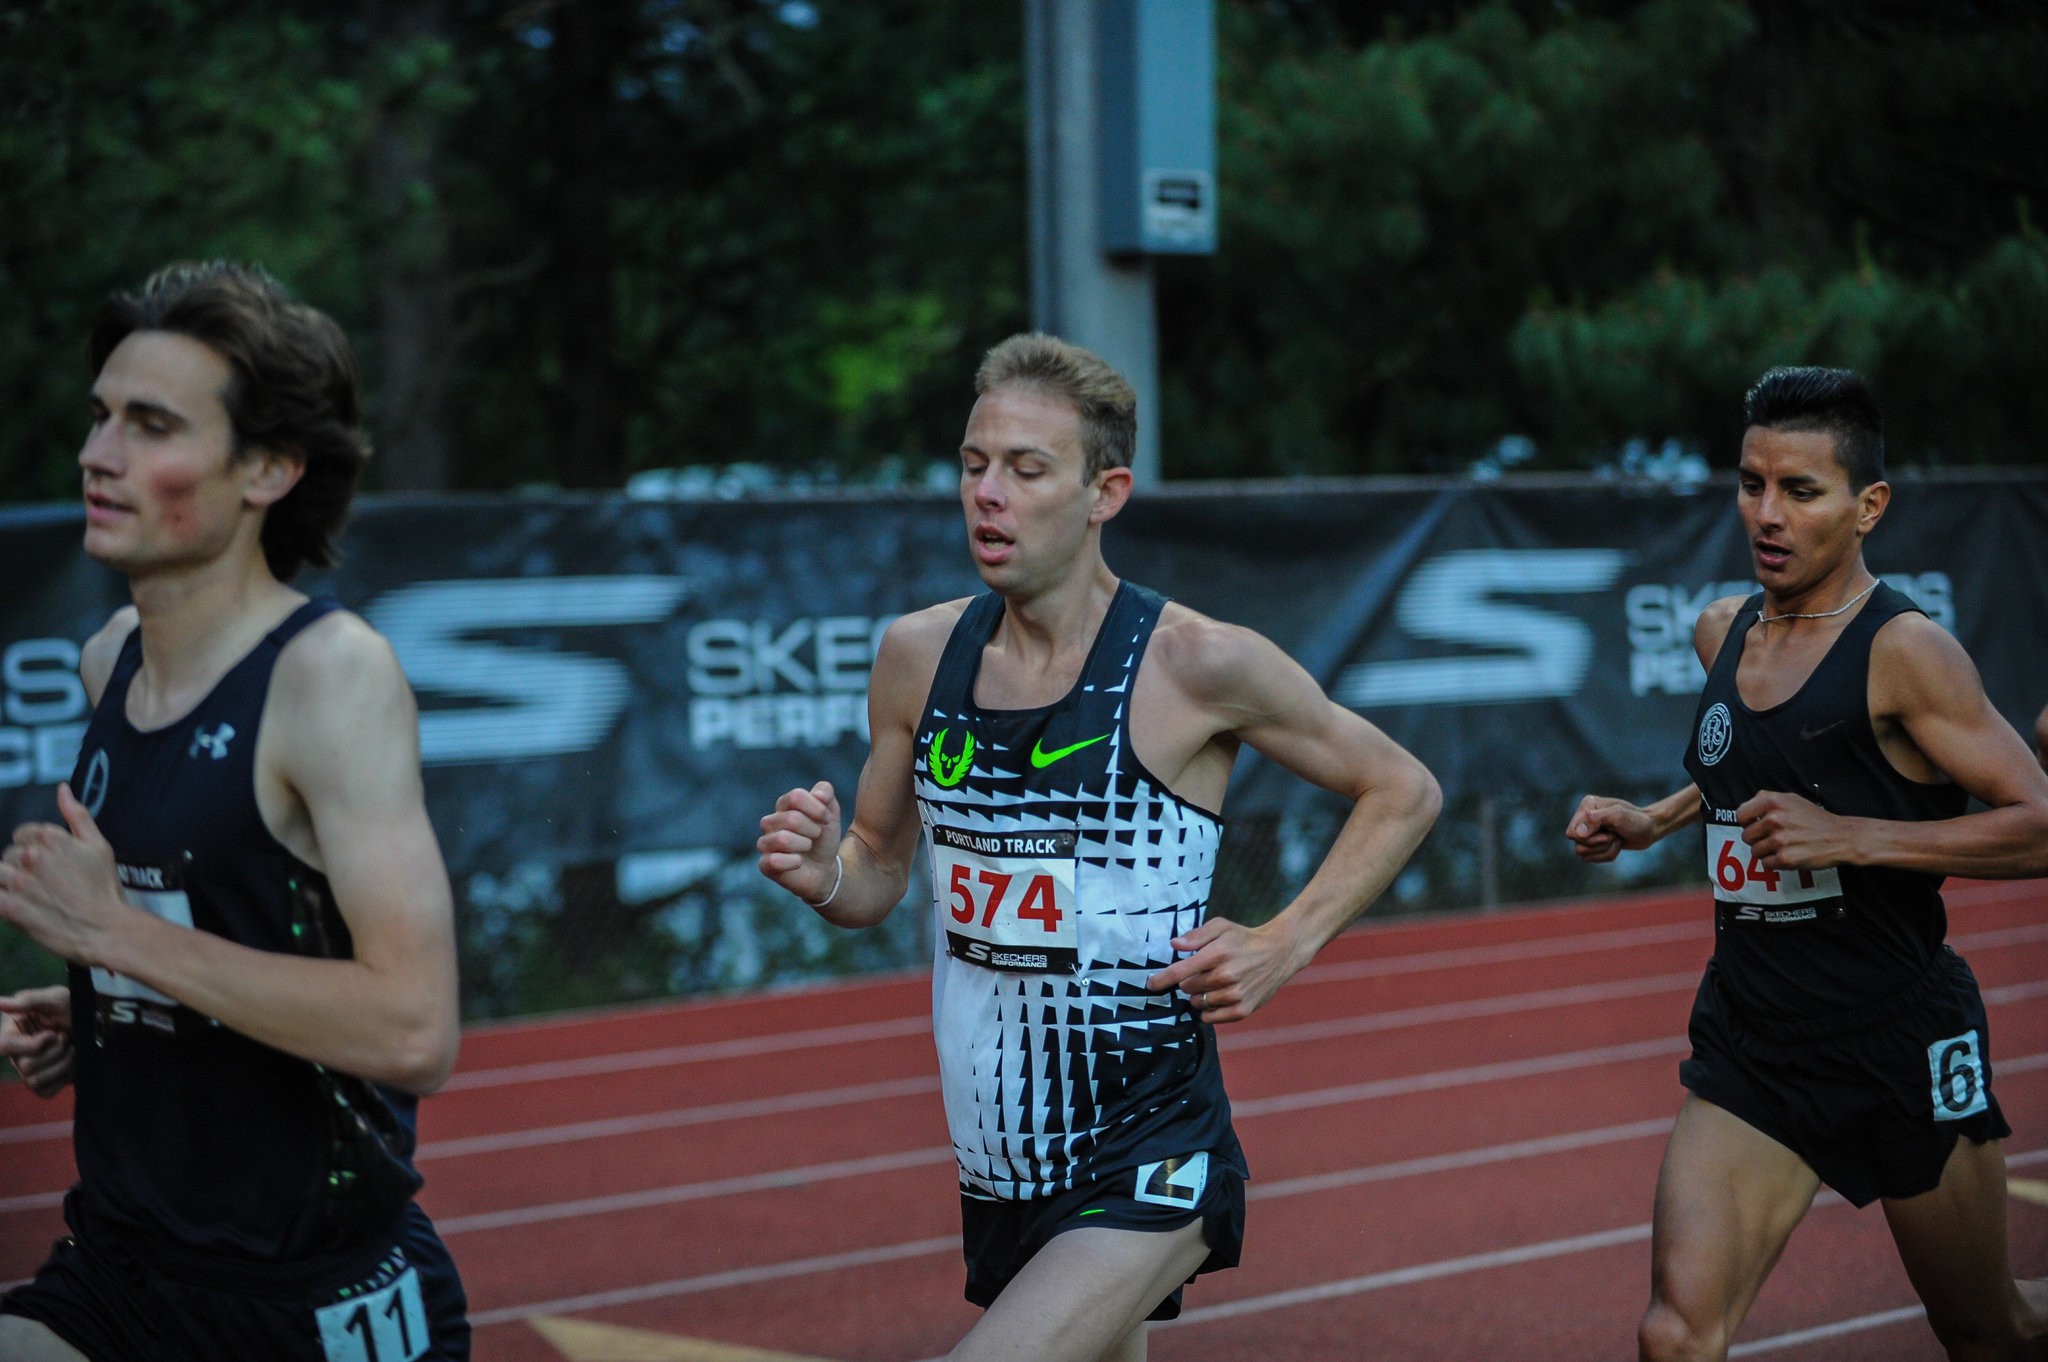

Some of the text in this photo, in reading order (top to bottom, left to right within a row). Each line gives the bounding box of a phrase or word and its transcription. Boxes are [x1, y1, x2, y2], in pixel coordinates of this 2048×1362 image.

[945, 829, 1057, 854] PORTLAND TRACK
[950, 863, 1063, 933] 574
[991, 951, 1048, 963] SKECHERS
[991, 959, 1048, 968] PERFORMANCE
[1939, 1040, 1977, 1112] 6
[344, 1286, 413, 1362] 11
